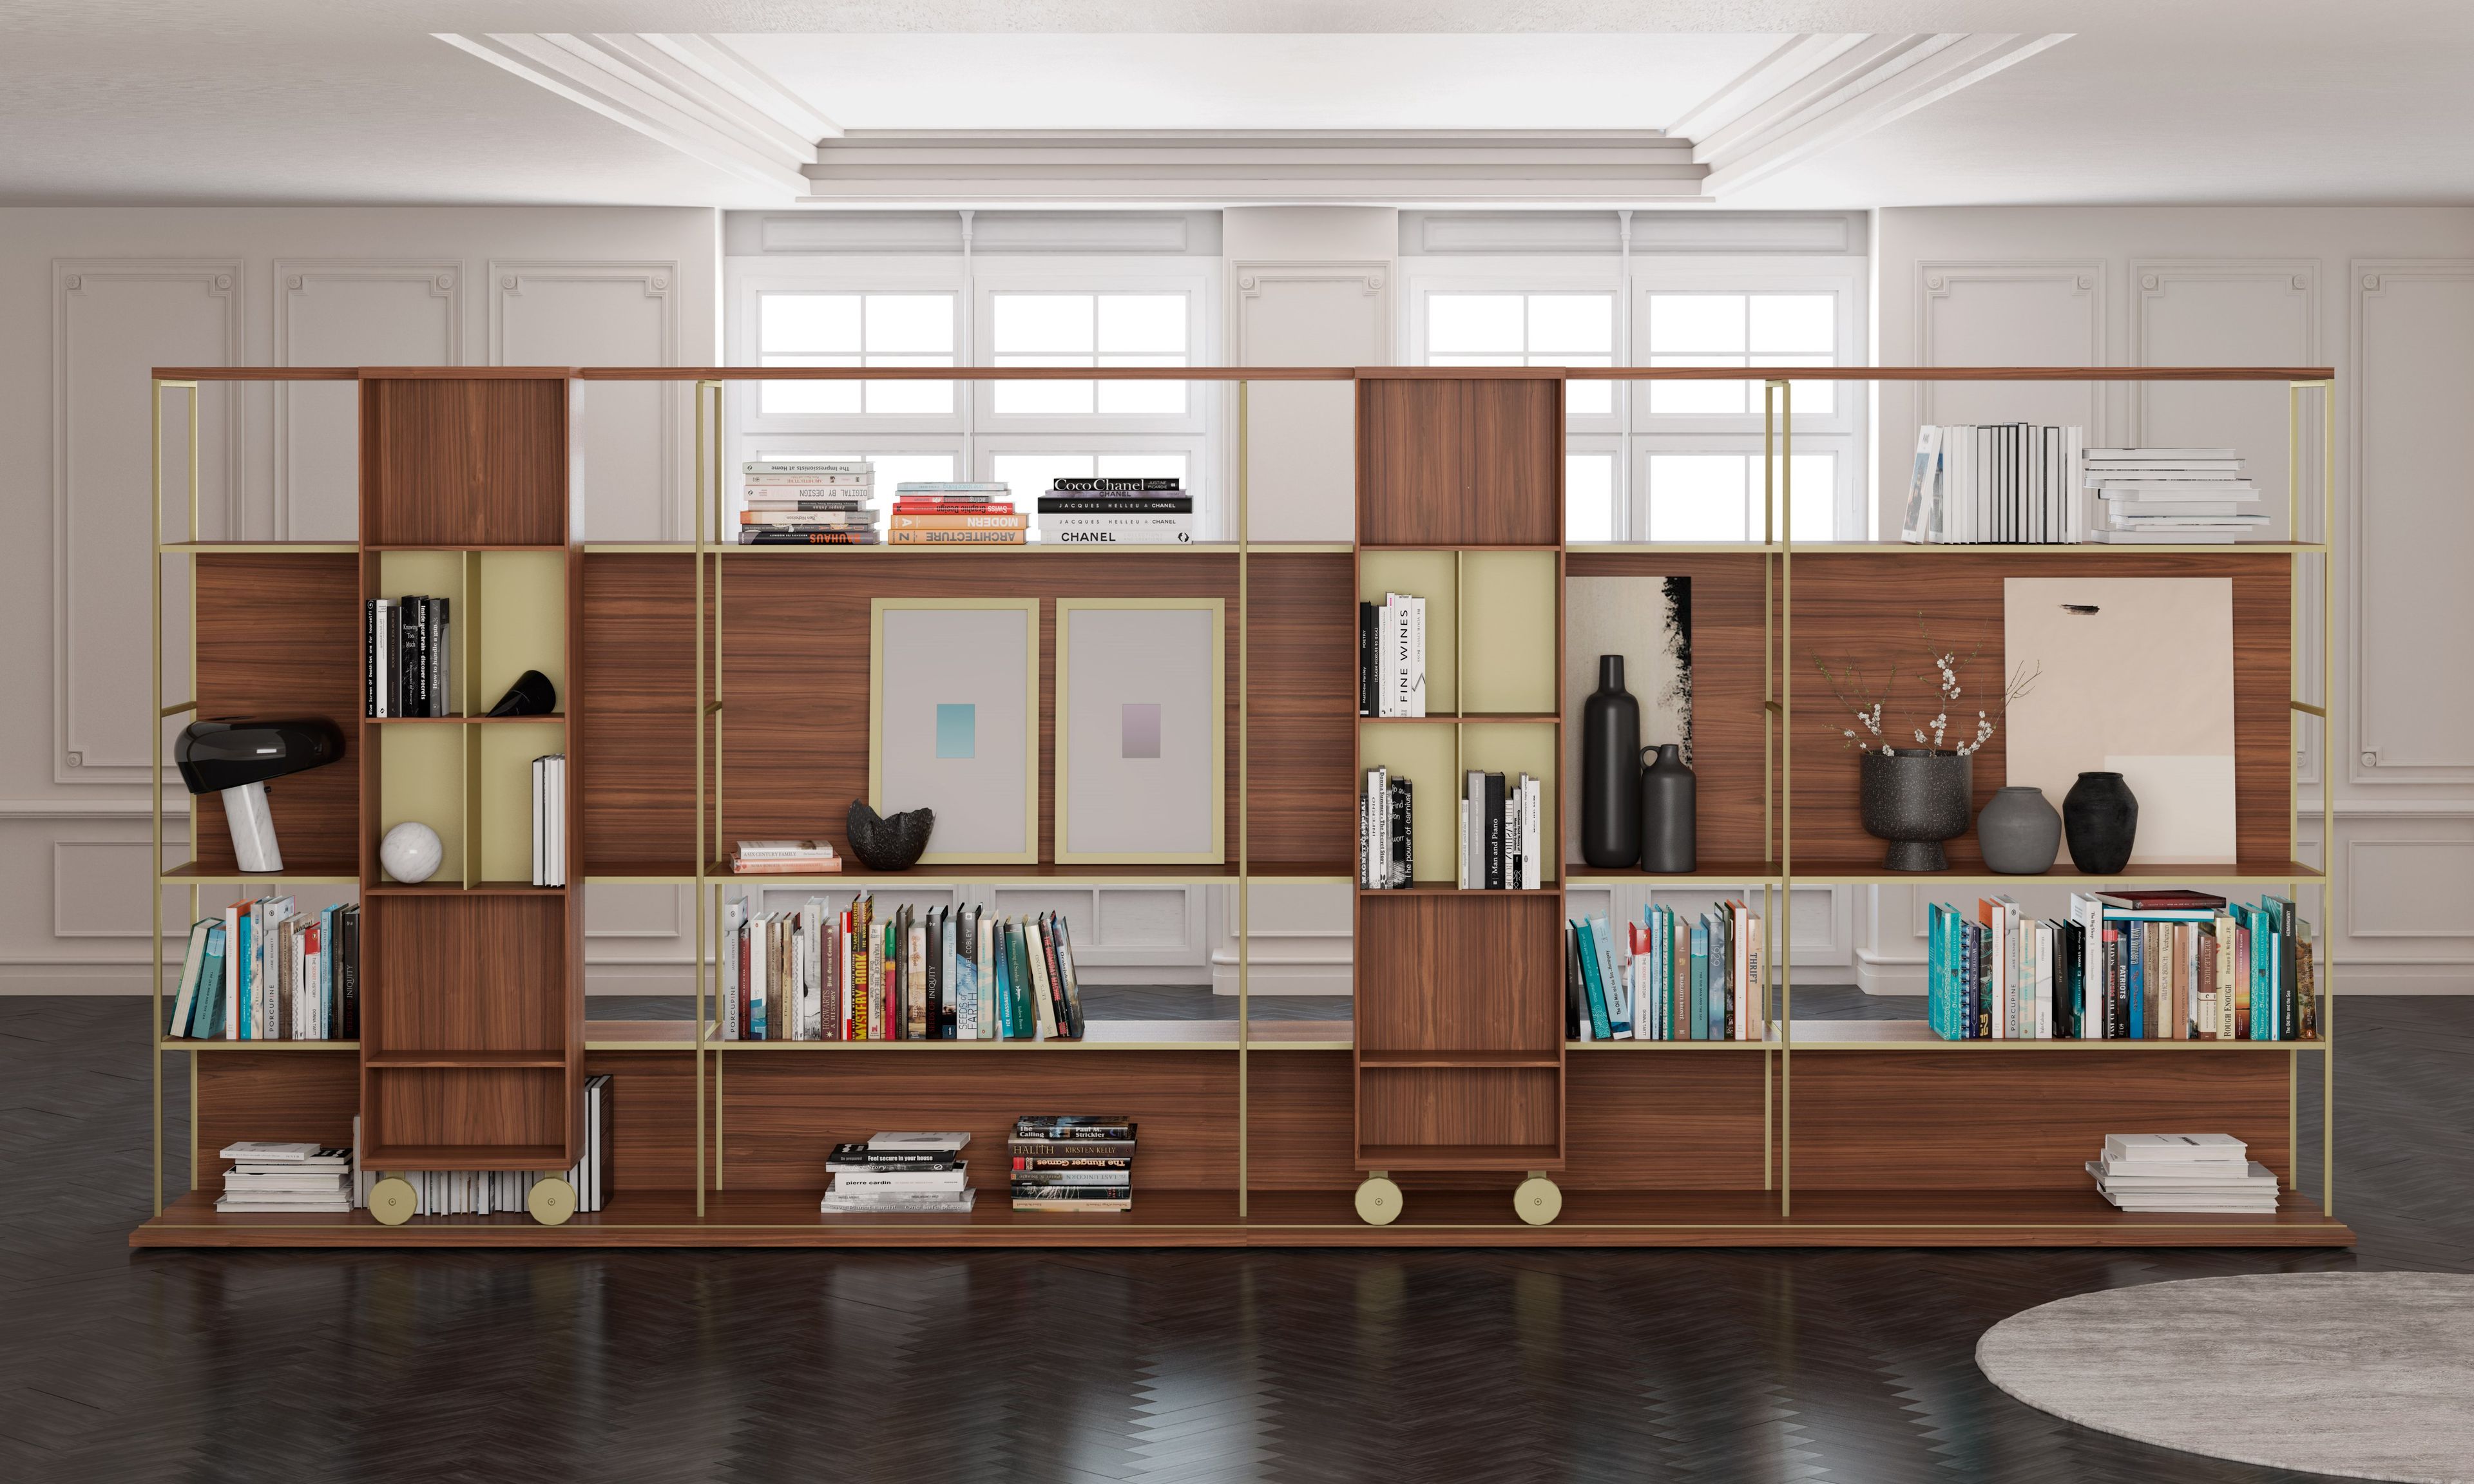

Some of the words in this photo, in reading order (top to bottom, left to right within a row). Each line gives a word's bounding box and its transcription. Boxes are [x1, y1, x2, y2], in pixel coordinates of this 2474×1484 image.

[1055, 479, 1091, 491] Coco
[1093, 479, 1145, 491] Chanel
[936, 504, 959, 513] Design
[960, 504, 986, 513] Graphic
[967, 517, 1019, 528] MODERN
[809, 534, 861, 543] BAUHAUS
[926, 532, 1016, 542] ARCHITECTURE
[1061, 532, 1116, 542] CHANEL
[1405, 826, 1411, 835] of
[2131, 928, 2141, 939] Witi
[1711, 944, 1720, 966] 1929
[2131, 940, 2141, 965] Ihimaera
[855, 953, 867, 985] BOOK
[874, 963, 880, 972] OF
[1035, 954, 1044, 982] PRETEND
[1045, 947, 1055, 976] DOOMSDAY
[1051, 976, 1061, 1002] MACHINE
[1060, 951, 1069, 987] Draksjukan
[959, 992, 966, 1001] of
[2223, 984, 2232, 1012] ENOUGH
[855, 989, 867, 1040] MYSTERY
[958, 1002, 967, 1030] SEEDS
[967, 993, 977, 1030] EARTH
[2223, 1014, 2232, 1037] ROUGH
